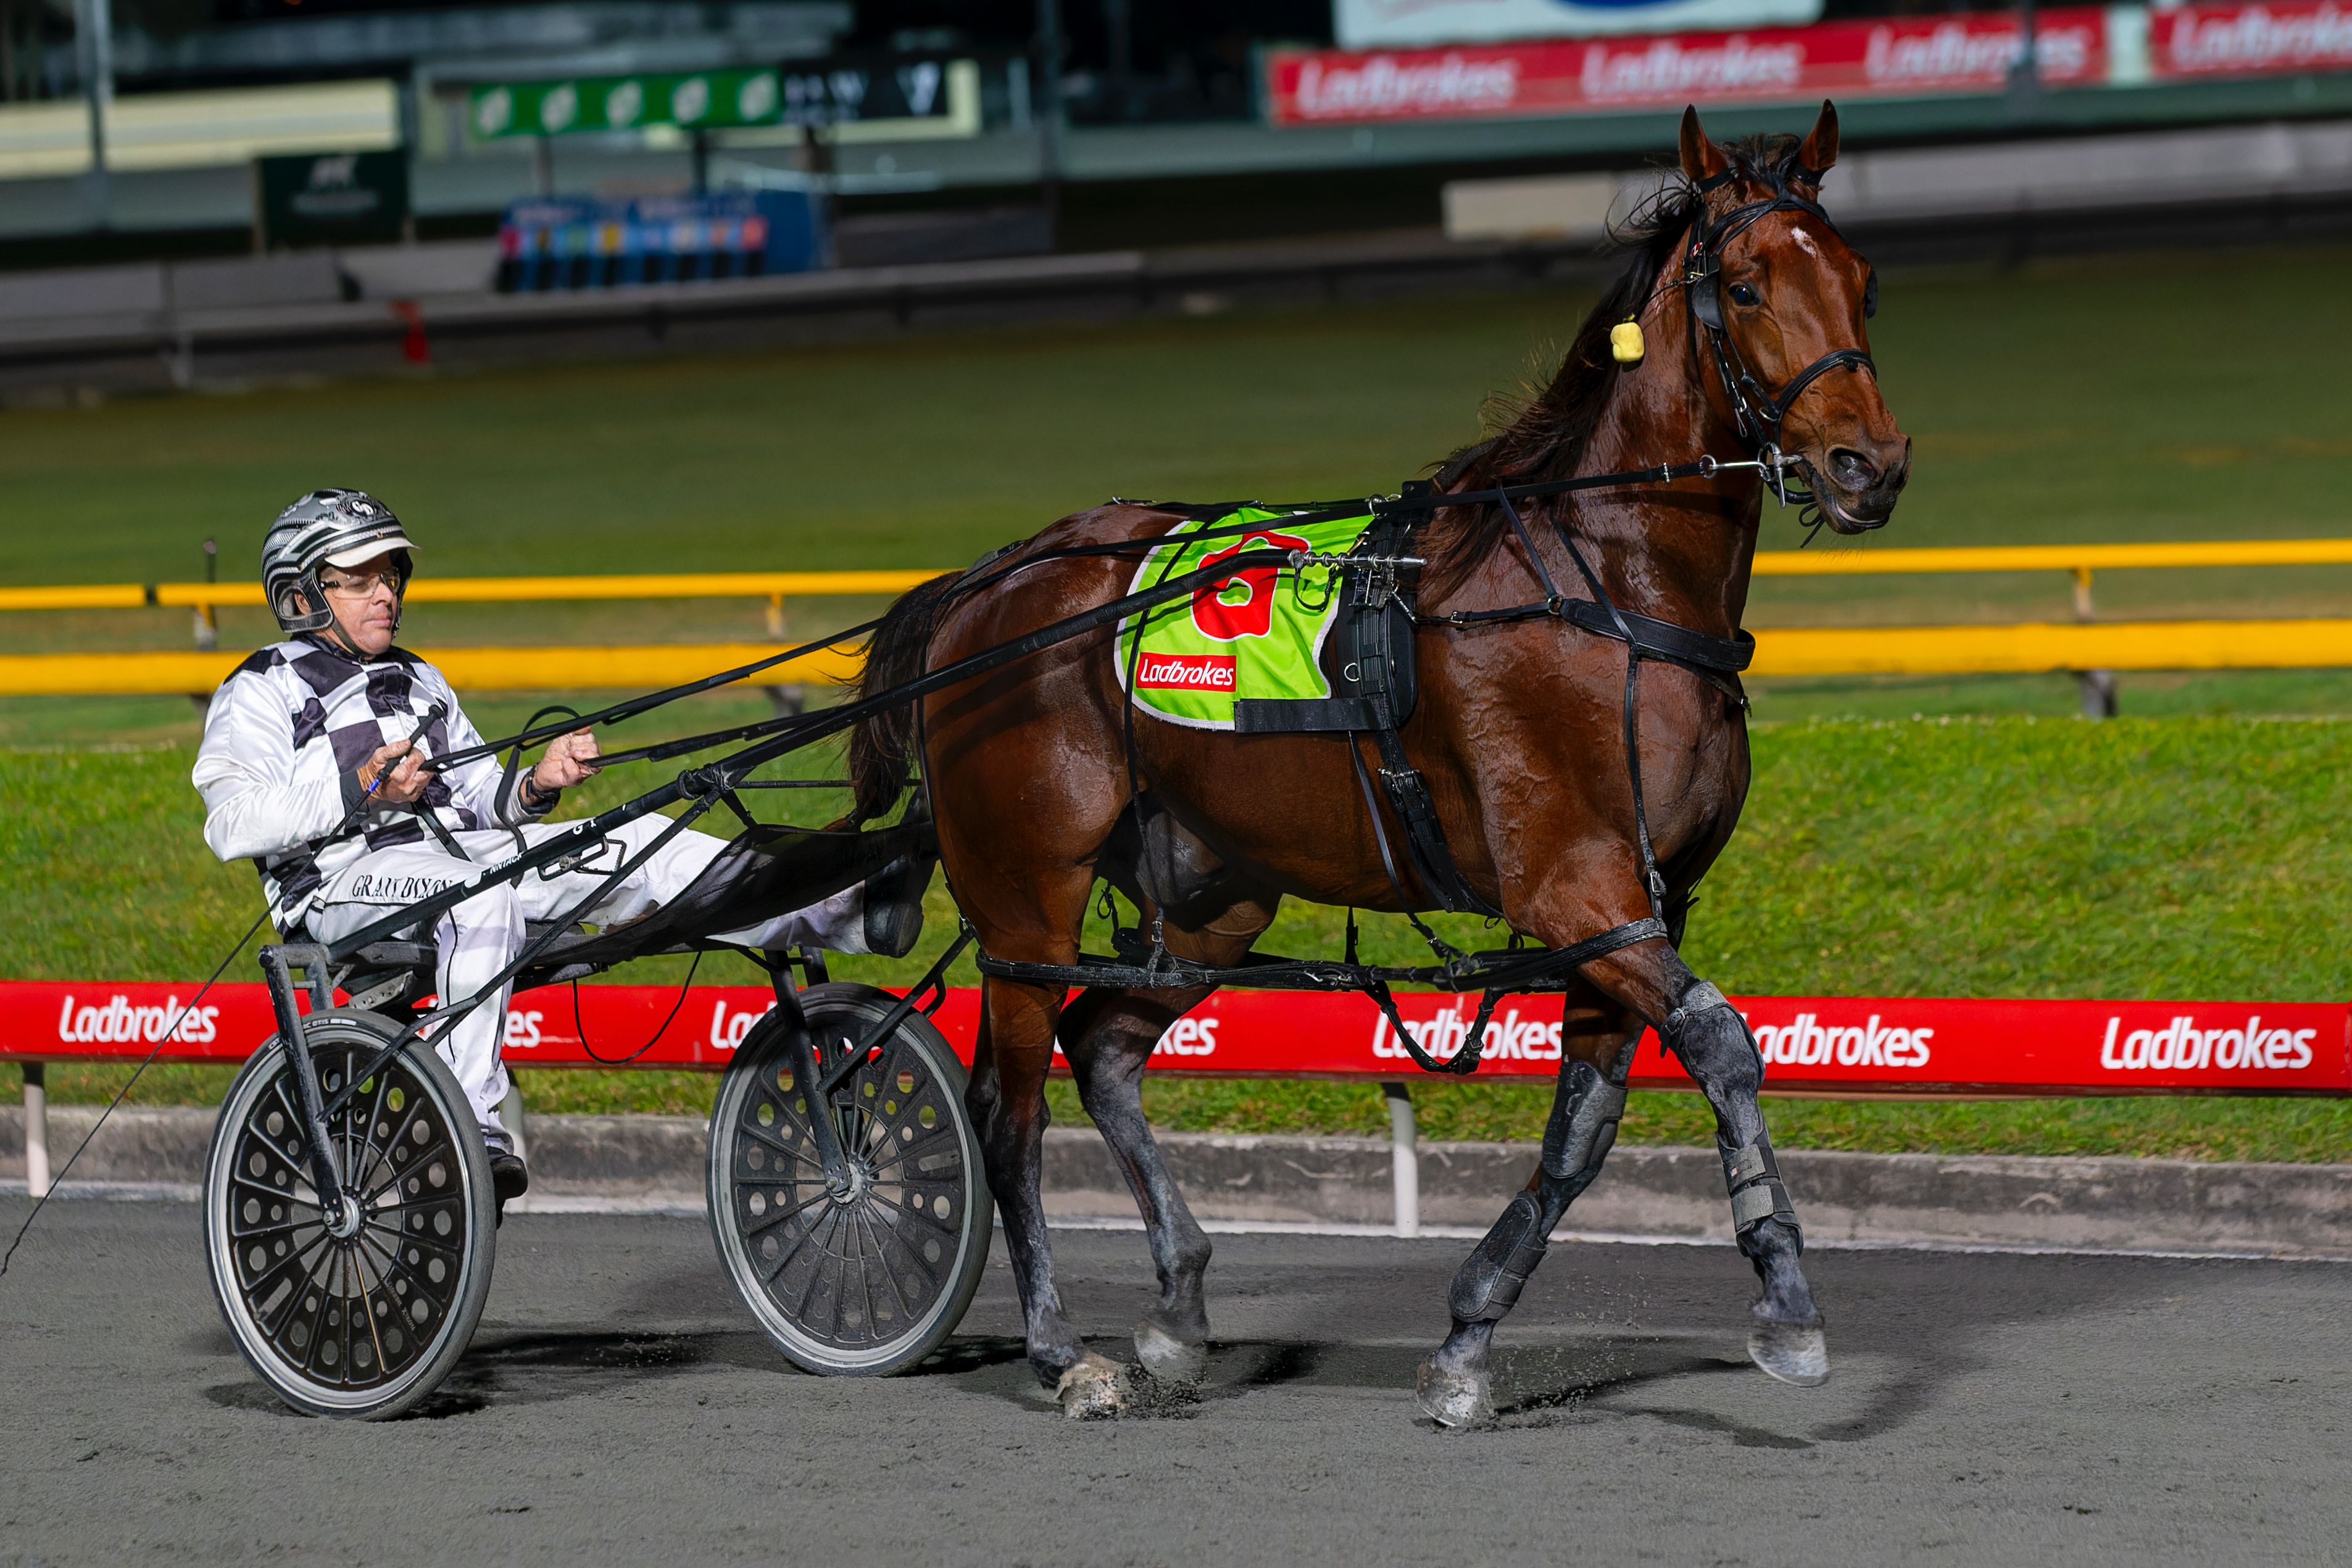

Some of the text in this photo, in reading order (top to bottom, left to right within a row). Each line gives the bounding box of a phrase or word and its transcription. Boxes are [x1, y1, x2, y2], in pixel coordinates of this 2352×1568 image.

[2172, 2, 2352, 71] Ladbrok
[1298, 56, 1521, 117] Ladbrokes
[1581, 35, 1806, 102] Ladbrokes
[1190, 528, 1312, 643] 6
[1140, 658, 1234, 686] Ladbrokes
[59, 994, 220, 1043] Ladbrokes
[1372, 1008, 1563, 1060] Ladbokes
[1739, 1012, 1934, 1067] adbrokes
[2100, 1016, 2317, 1069] Ladbrokes
